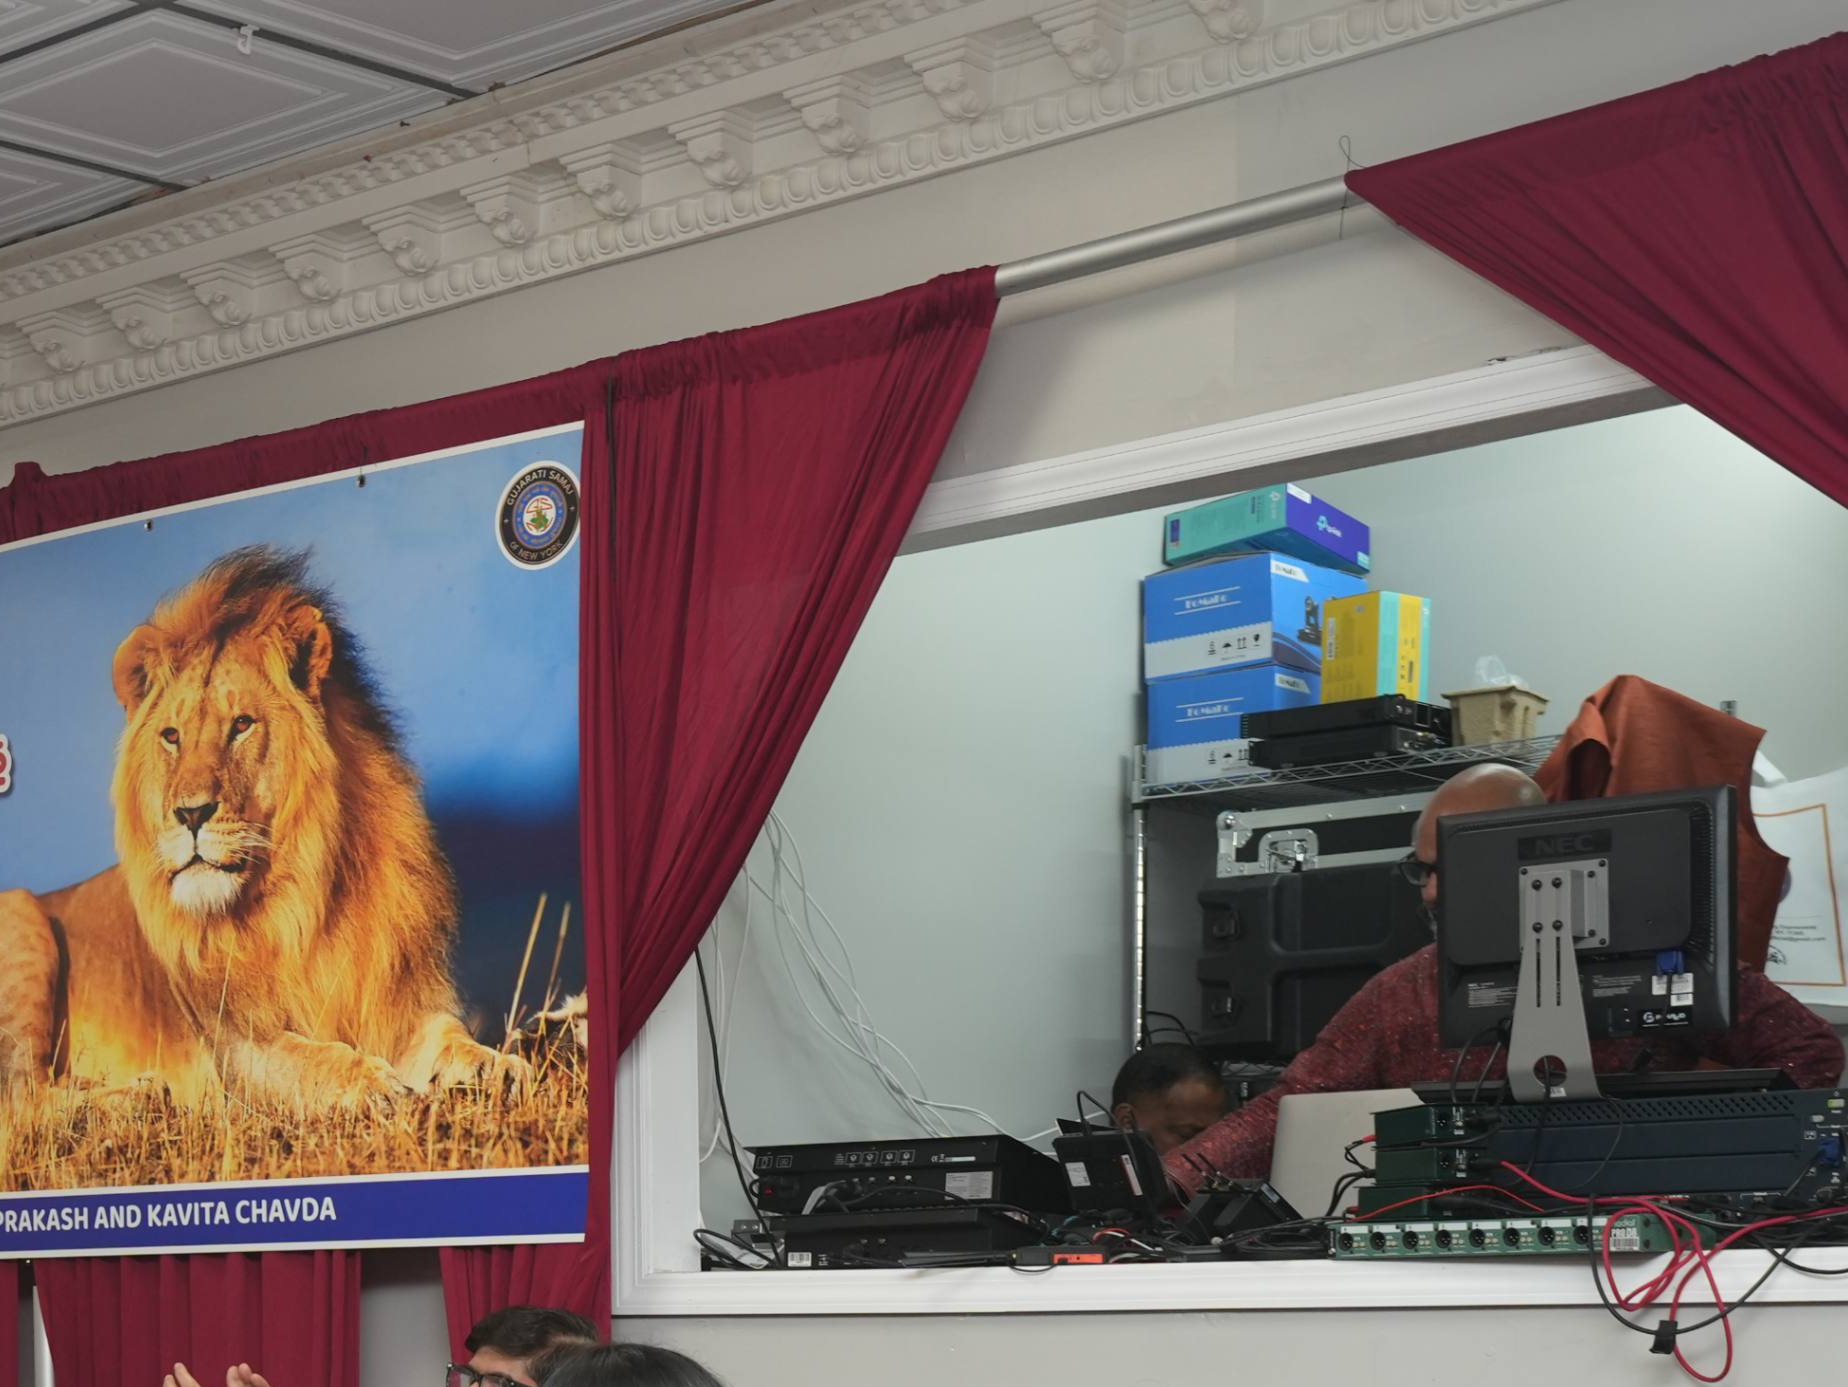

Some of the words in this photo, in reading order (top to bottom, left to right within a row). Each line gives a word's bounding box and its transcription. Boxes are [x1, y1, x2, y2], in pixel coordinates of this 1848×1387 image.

[507, 469, 547, 505] GUJARATI
[549, 470, 574, 494] SAMAJ
[519, 547, 539, 560] NEW
[540, 542, 563, 560] YORK
[1535, 835, 1594, 856] NEC
[94, 1205, 142, 1229] AND
[147, 1201, 230, 1227] KAVITA
[235, 1197, 337, 1224] CHAVDA
